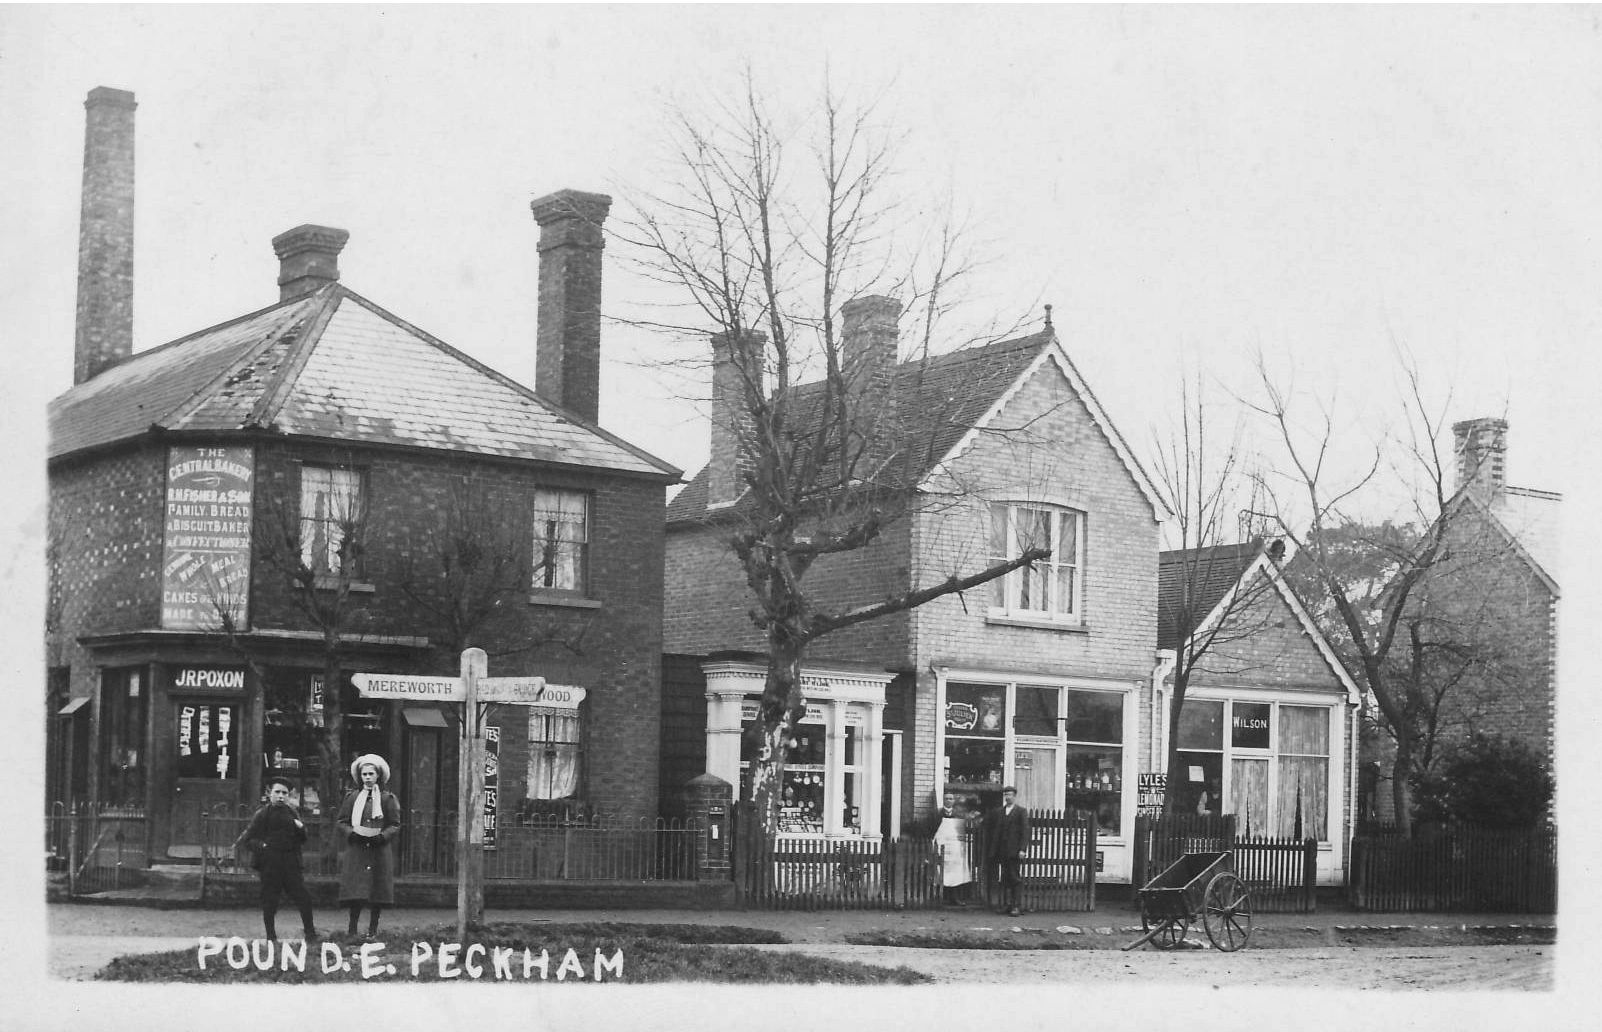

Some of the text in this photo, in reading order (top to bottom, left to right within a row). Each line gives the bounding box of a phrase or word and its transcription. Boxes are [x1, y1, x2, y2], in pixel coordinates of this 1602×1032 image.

[197, 448, 226, 457] THE
[169, 459, 252, 482] CENTRAL BAKERY
[210, 505, 249, 517] BREAD
[214, 520, 249, 533] BAKER
[163, 591, 198, 604] CAKES
[367, 679, 453, 695] MEREWORTH
[1232, 716, 1268, 729] WILSON
[1137, 793, 1165, 806] LEMONAD
